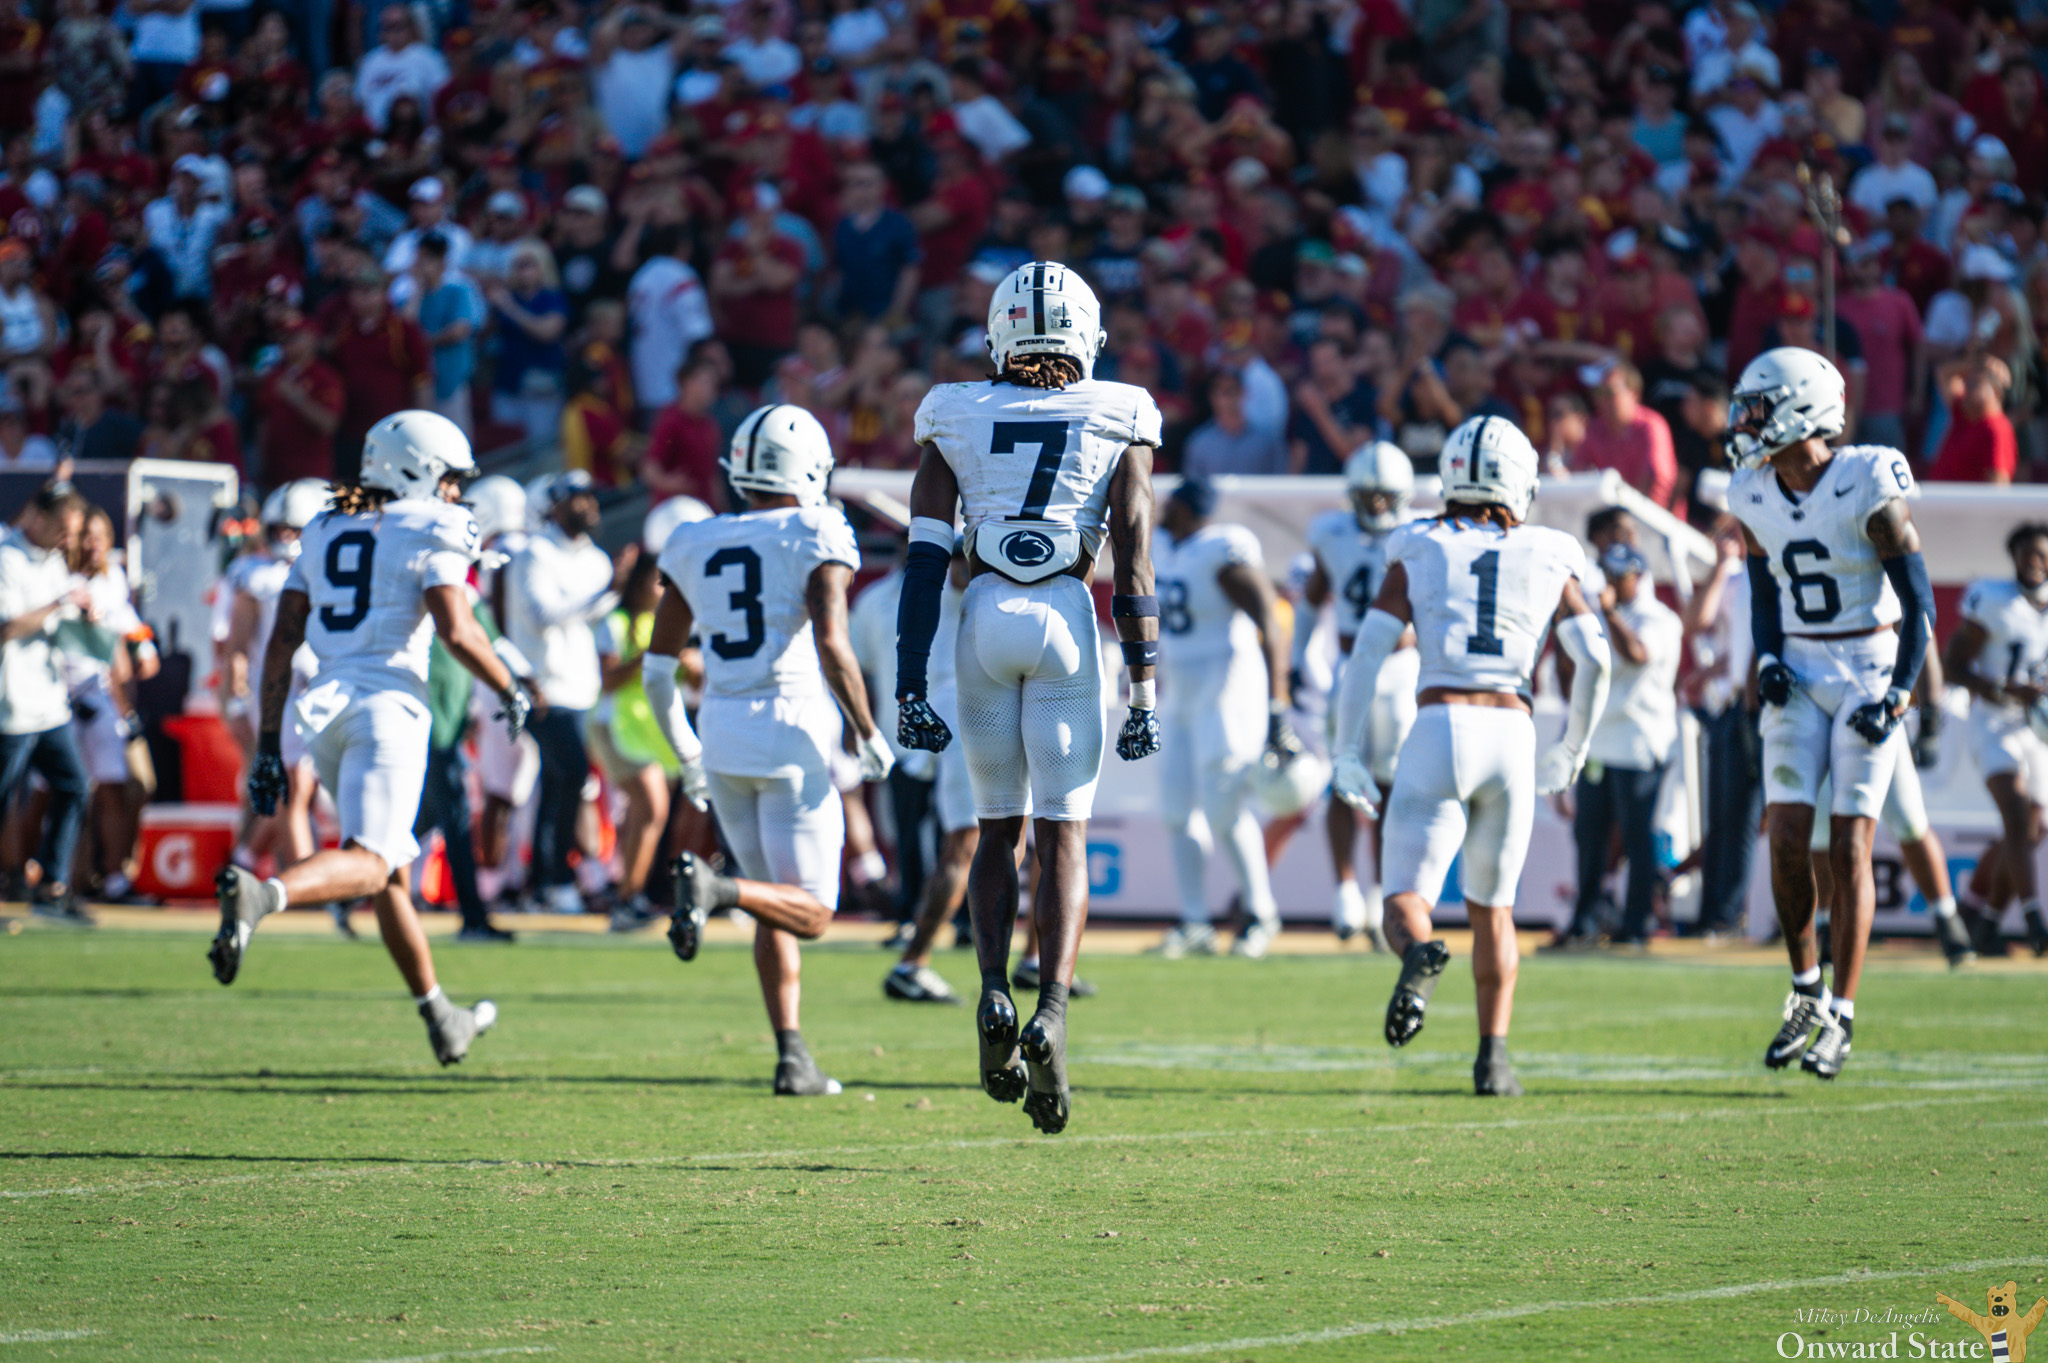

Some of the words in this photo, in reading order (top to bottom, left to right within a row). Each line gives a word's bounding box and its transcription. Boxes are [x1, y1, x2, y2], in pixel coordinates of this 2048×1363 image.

[990, 420, 1070, 522] 7
[1891, 461, 1909, 490] 6
[319, 530, 377, 632] 9
[703, 545, 765, 660] 3
[1466, 549, 1504, 656] 1
[1782, 538, 1843, 625] 6
[153, 832, 195, 889] G
